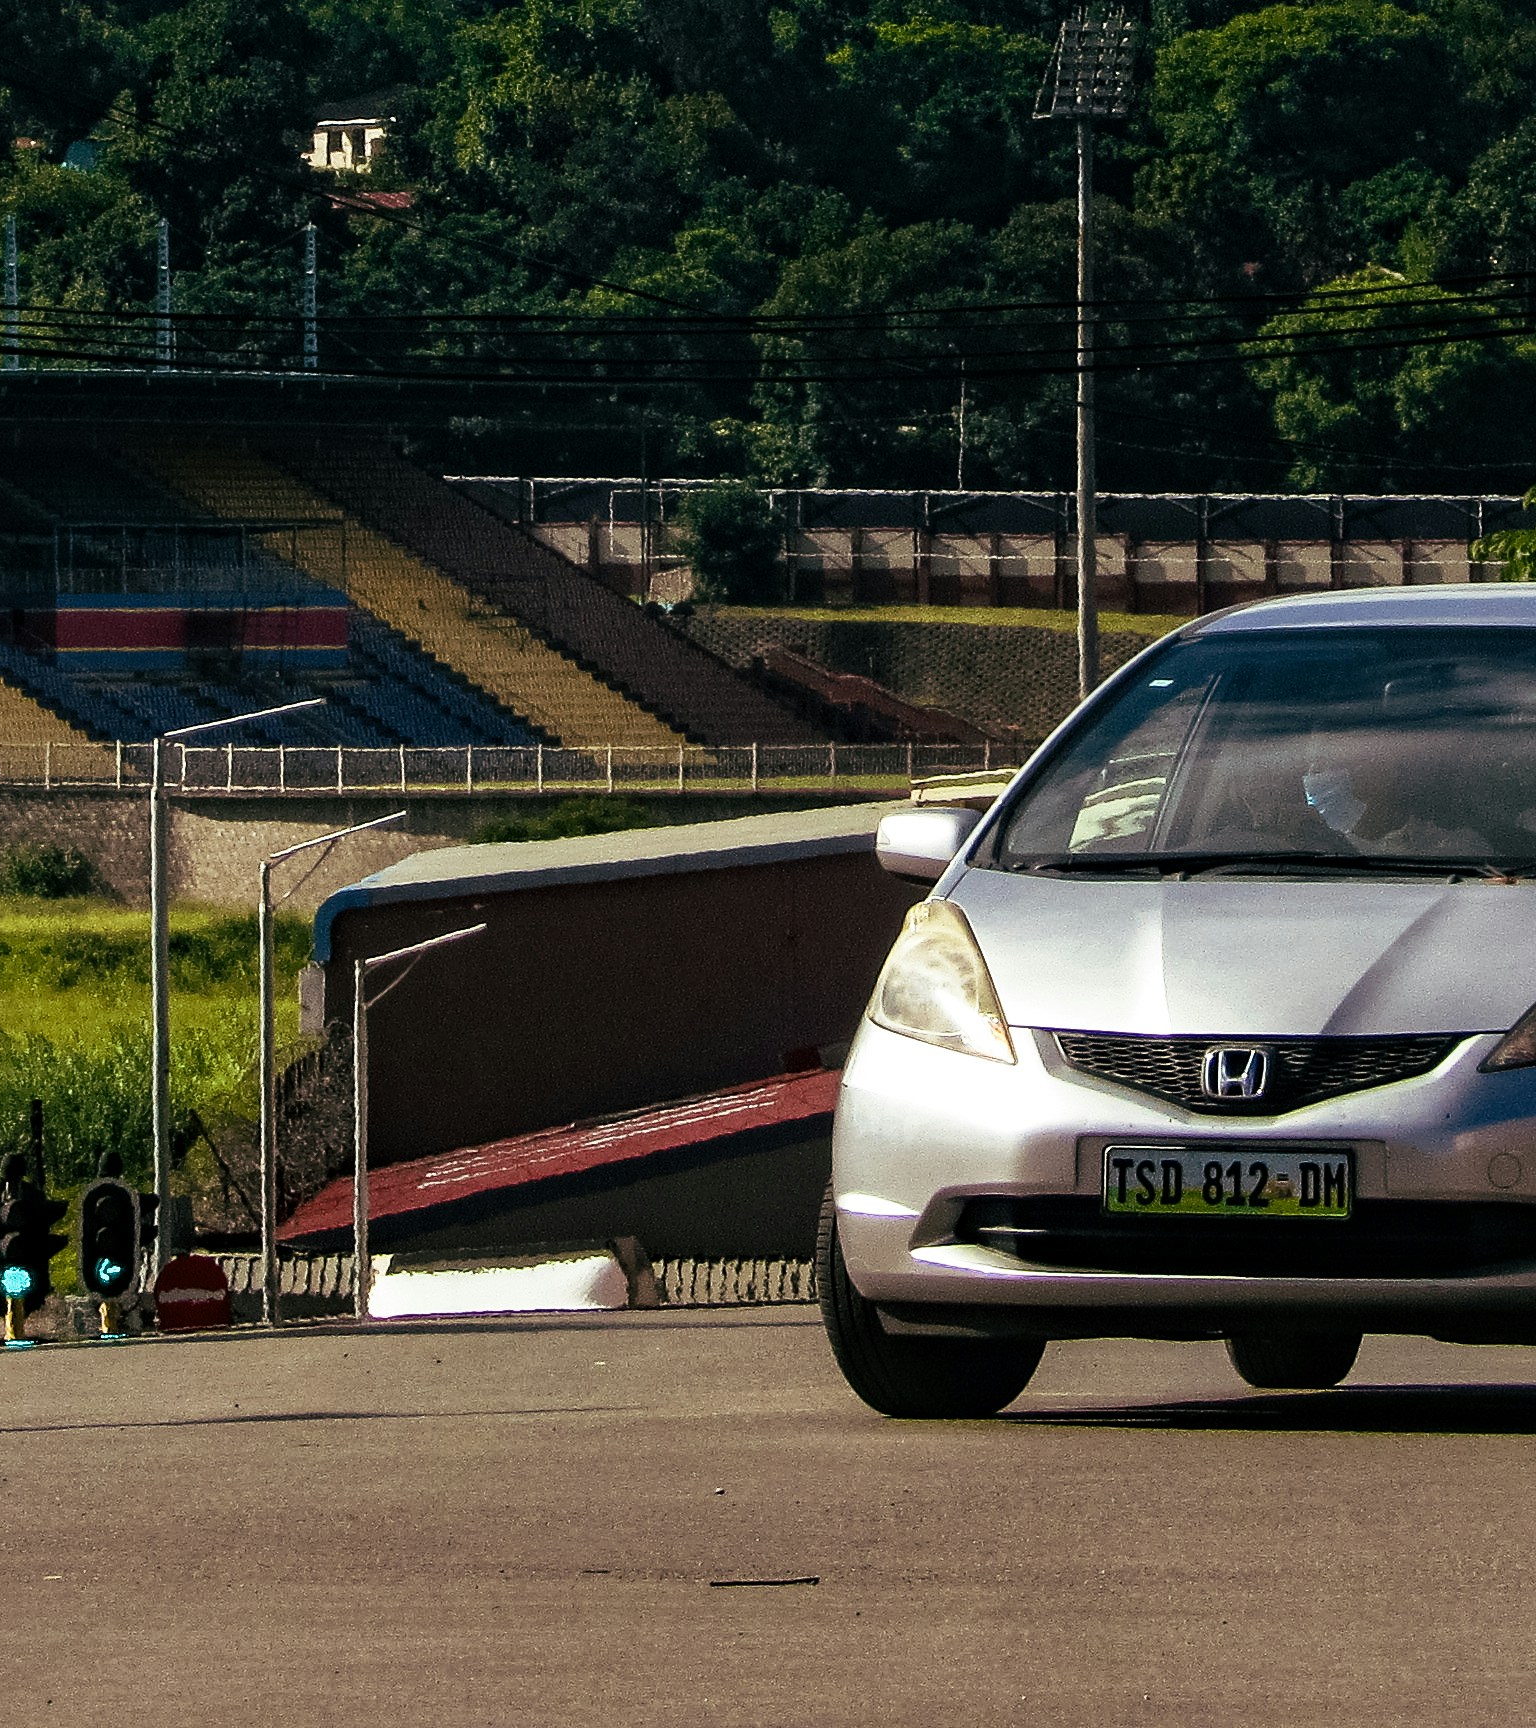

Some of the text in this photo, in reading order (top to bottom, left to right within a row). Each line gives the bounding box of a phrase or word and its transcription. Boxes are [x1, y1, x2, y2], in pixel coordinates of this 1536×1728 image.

[1112, 1158, 1346, 1209] TSD 812 DM
